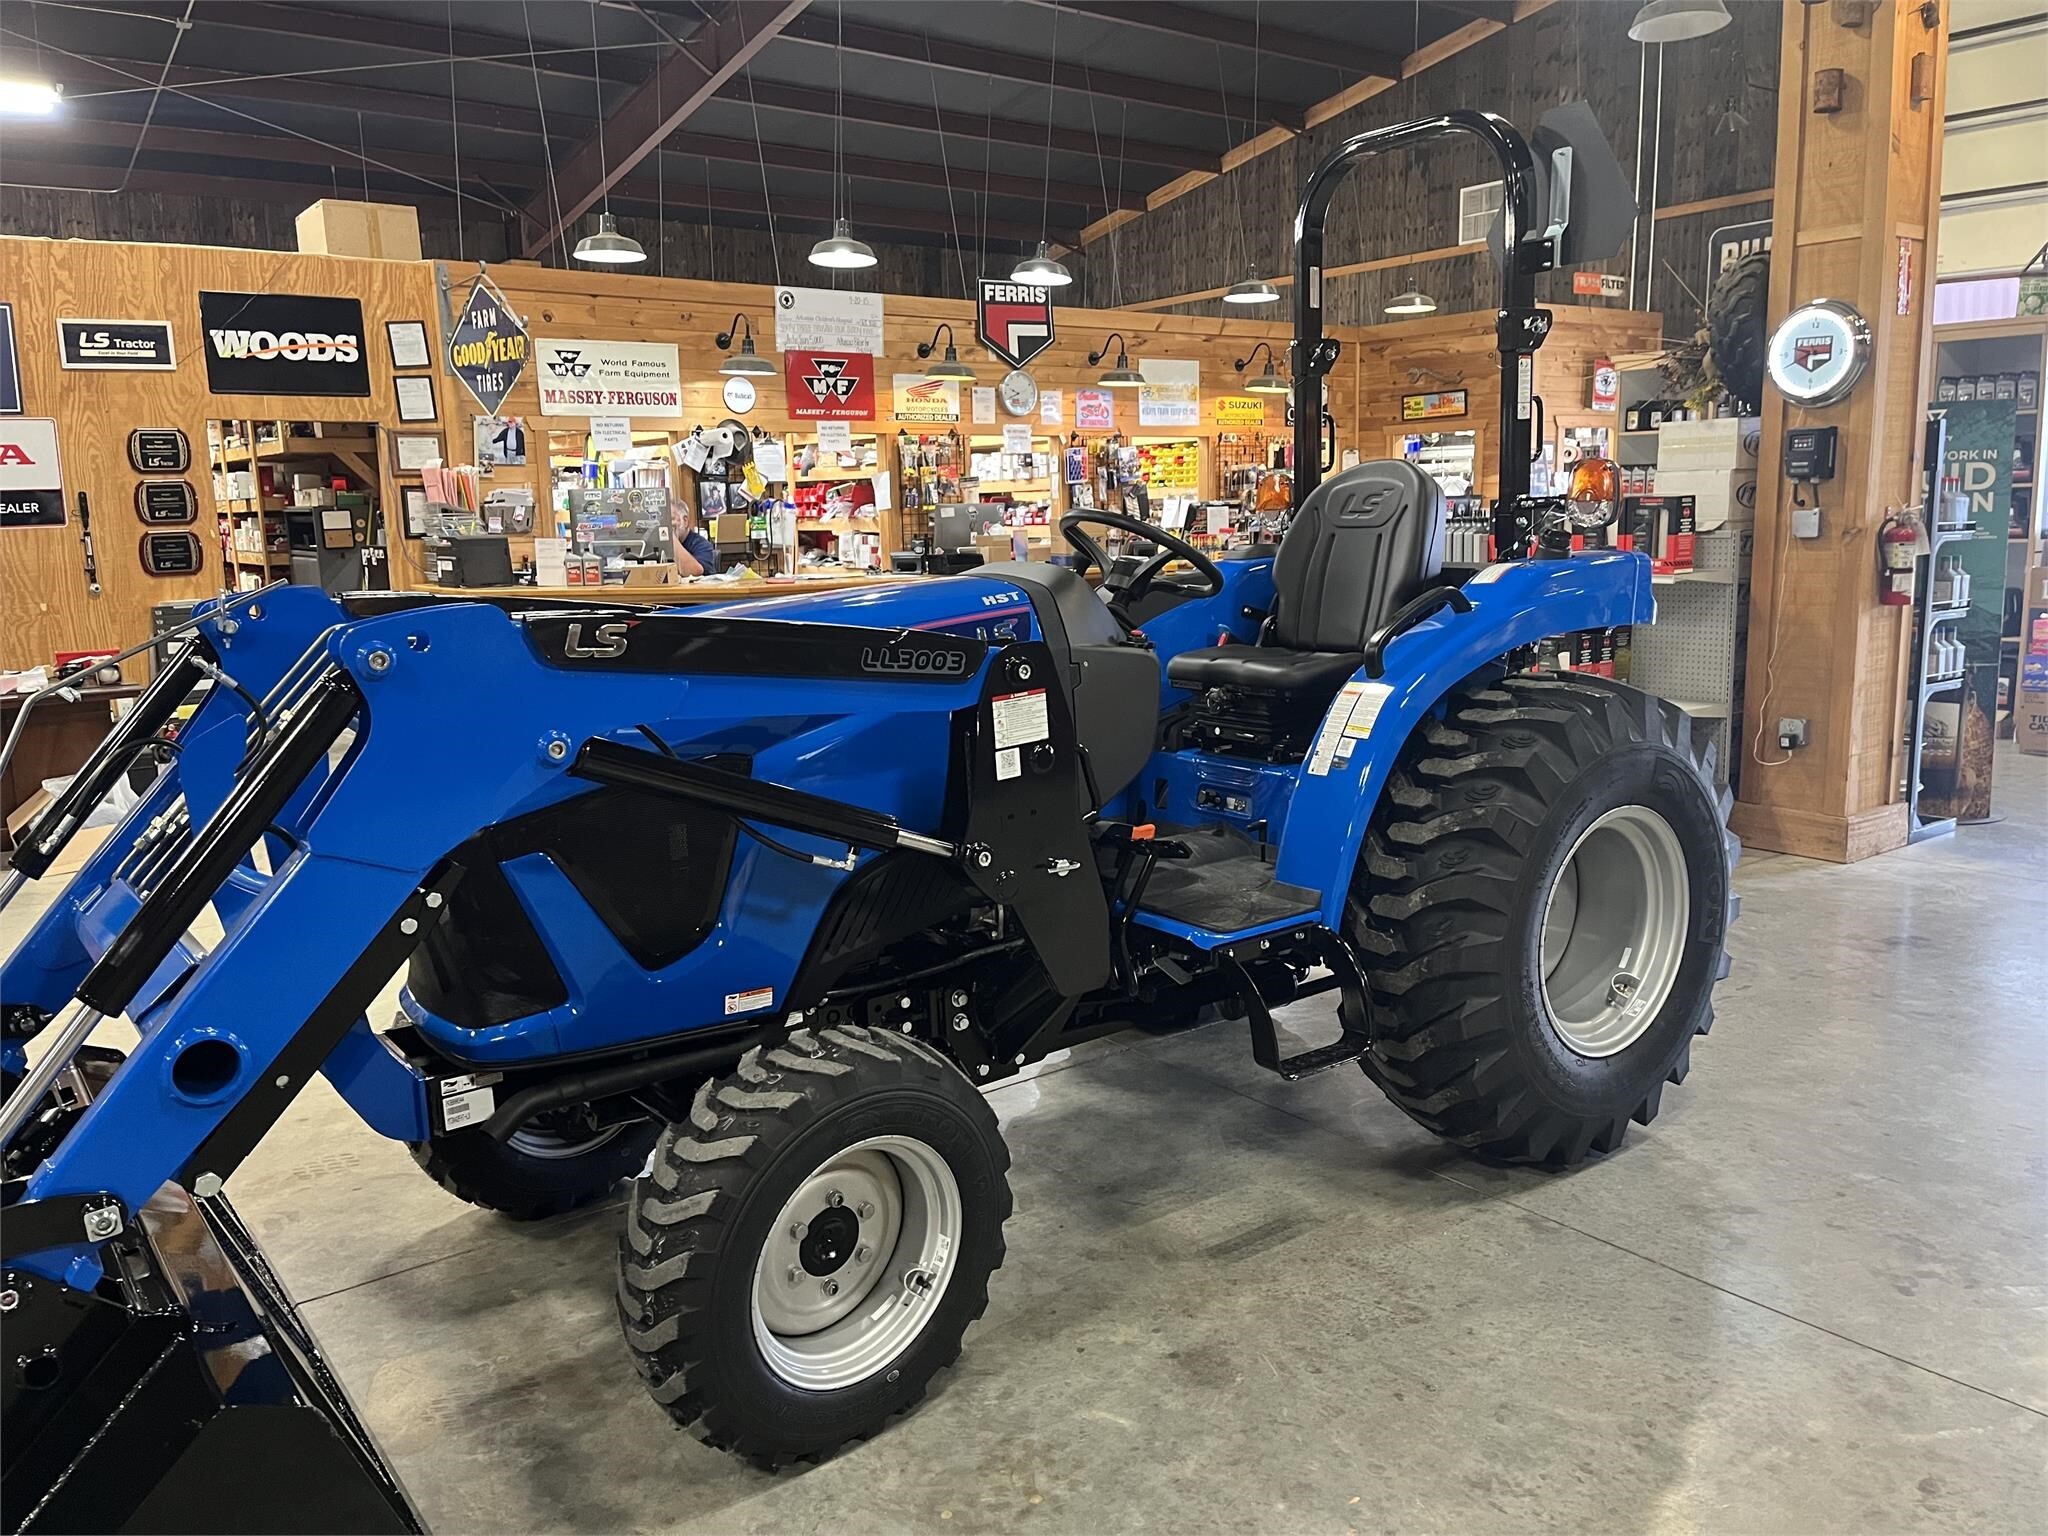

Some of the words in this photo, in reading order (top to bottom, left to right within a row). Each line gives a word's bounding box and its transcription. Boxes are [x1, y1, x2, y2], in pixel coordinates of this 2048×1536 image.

[984, 284, 1046, 304] FERRIS
[472, 307, 497, 329] FARM
[79, 332, 110, 348] LS
[113, 339, 156, 349] Tractor
[209, 330, 359, 363] WOODS
[1797, 337, 1832, 347] FERRIS
[453, 335, 526, 367] GOODYEAR
[601, 359, 627, 367] World
[632, 360, 666, 368] Famous
[476, 372, 504, 392] TIRES
[624, 370, 670, 379] Equipment
[1228, 401, 1262, 409] SUZUKI
[897, 413, 934, 421] AUTHORIZED
[149, 457, 161, 467] LS
[1944, 450, 1979, 461] ORK
[1983, 449, 1998, 460] IN
[155, 509, 168, 517] LS
[1339, 491, 1386, 519] LS
[982, 591, 1020, 606] HST
[564, 623, 628, 658] LS
[861, 647, 967, 675] LL3003
